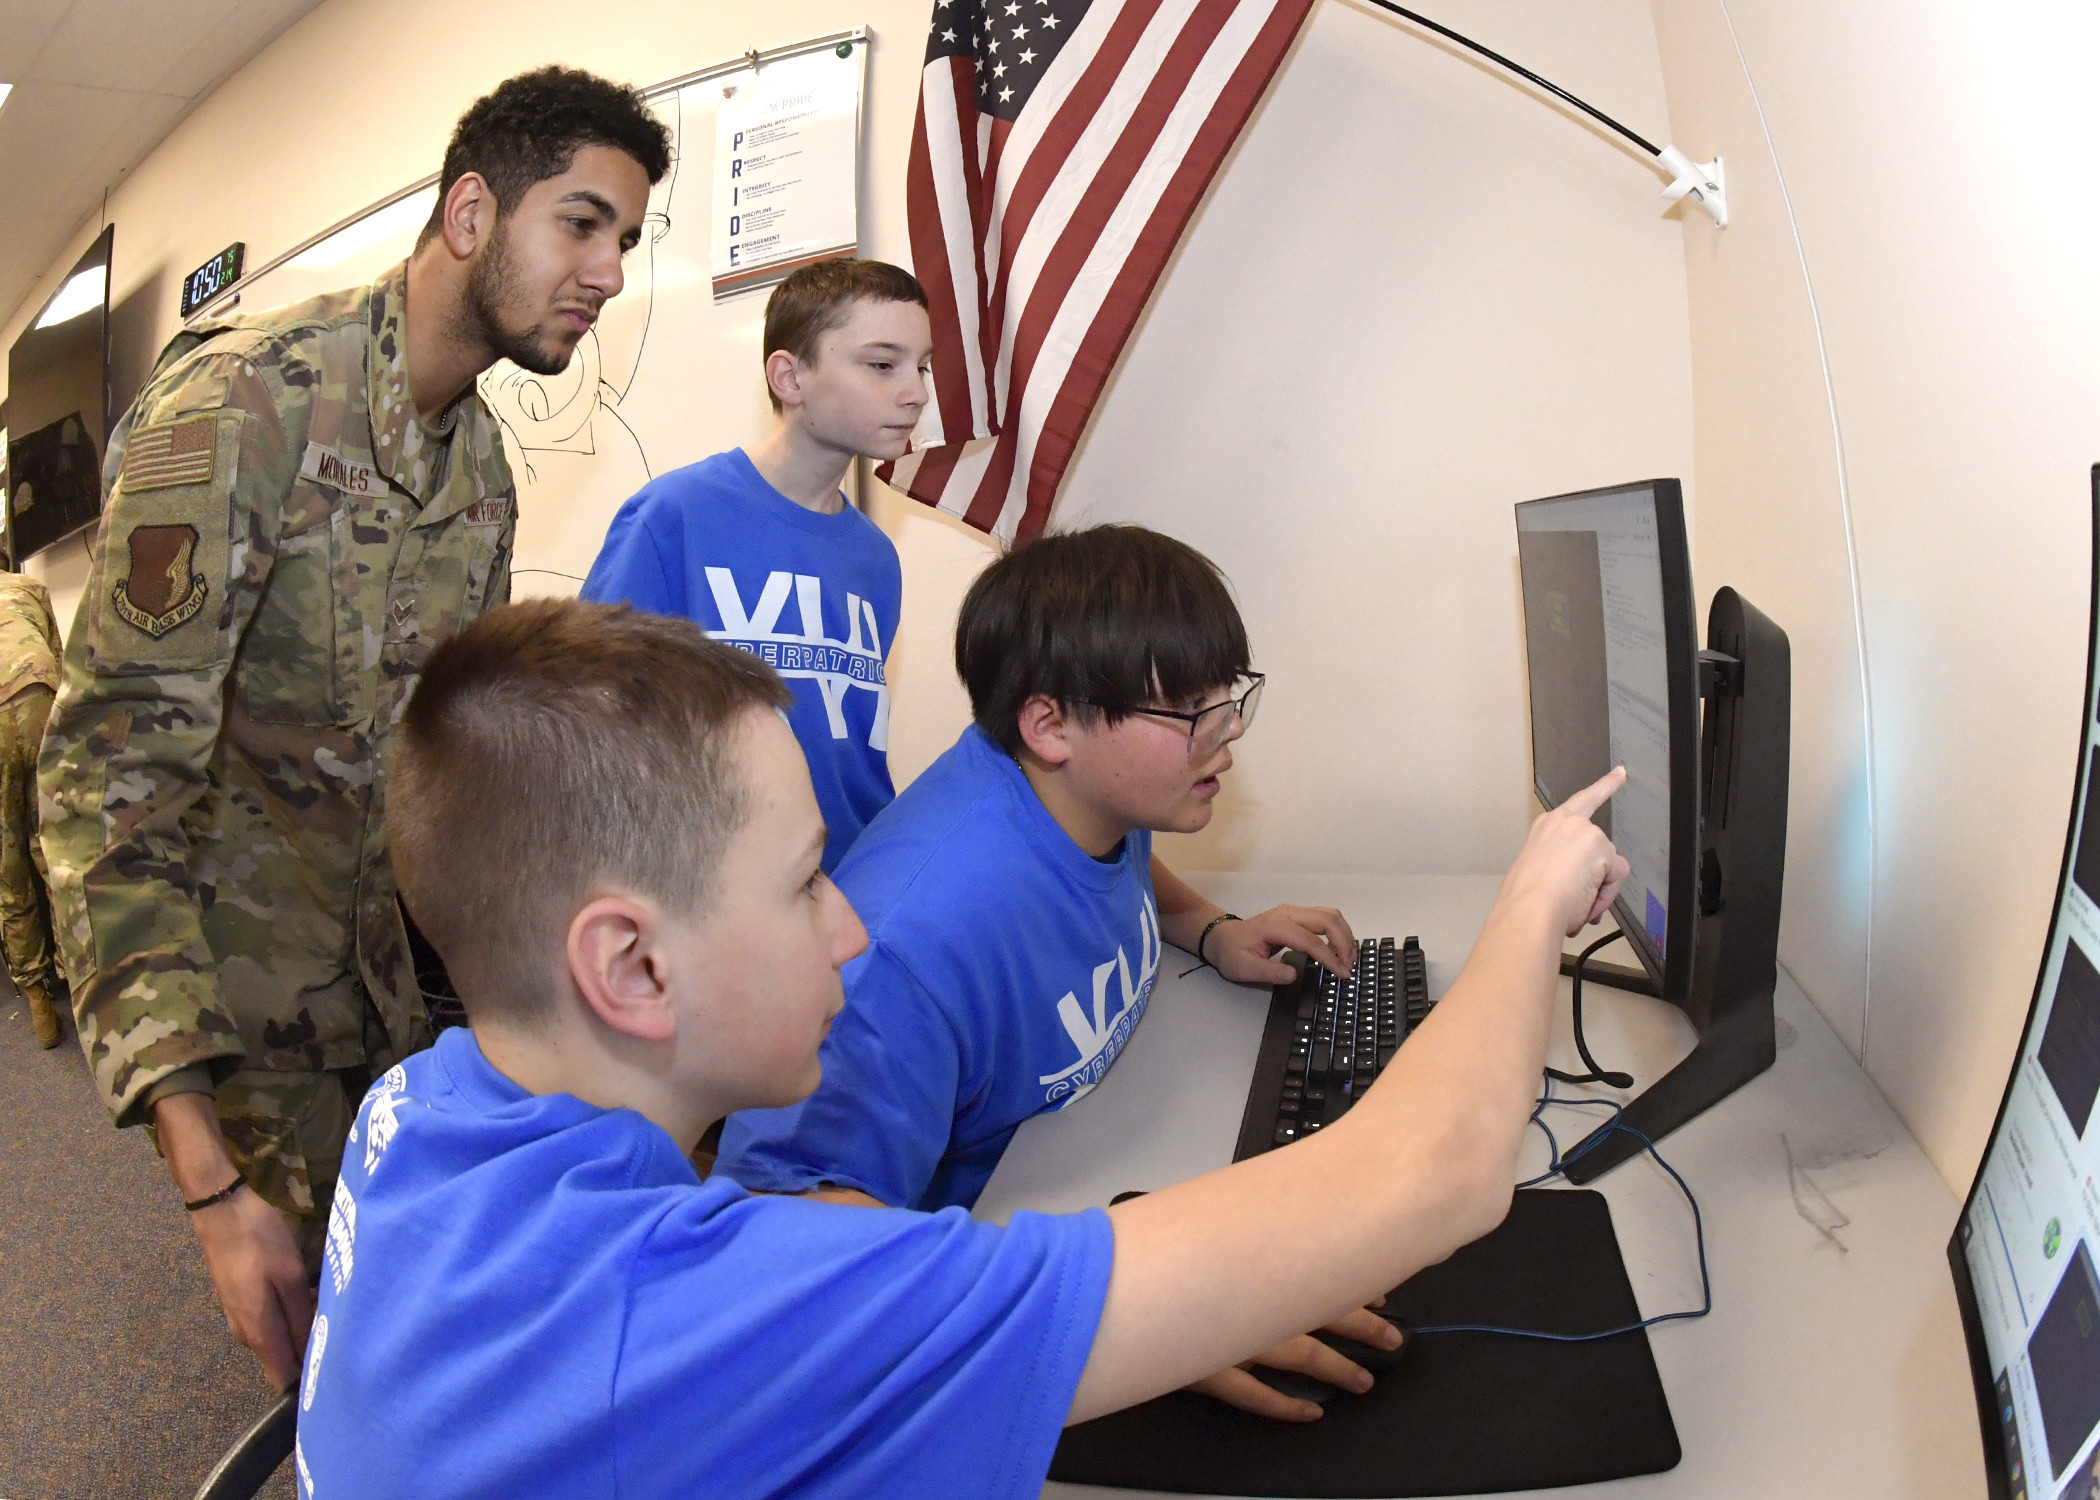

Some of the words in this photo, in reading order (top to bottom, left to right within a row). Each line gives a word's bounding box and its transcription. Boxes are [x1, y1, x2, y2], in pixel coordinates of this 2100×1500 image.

[745, 122, 774, 134] PERSONAL
[733, 131, 743, 152] P
[731, 158, 743, 179] R
[743, 154, 767, 166] RESPECT
[733, 187, 738, 207] I
[742, 181, 772, 194] INTEGRITY
[741, 206, 773, 220] DISCIPLINE
[730, 215, 741, 237] D
[741, 234, 781, 249] ENGAGEMENT
[730, 244, 741, 267] E
[117, 596, 132, 616] 75TH
[133, 609, 149, 628] AIR
[152, 614, 176, 633] BASE
[176, 593, 203, 620] WING
